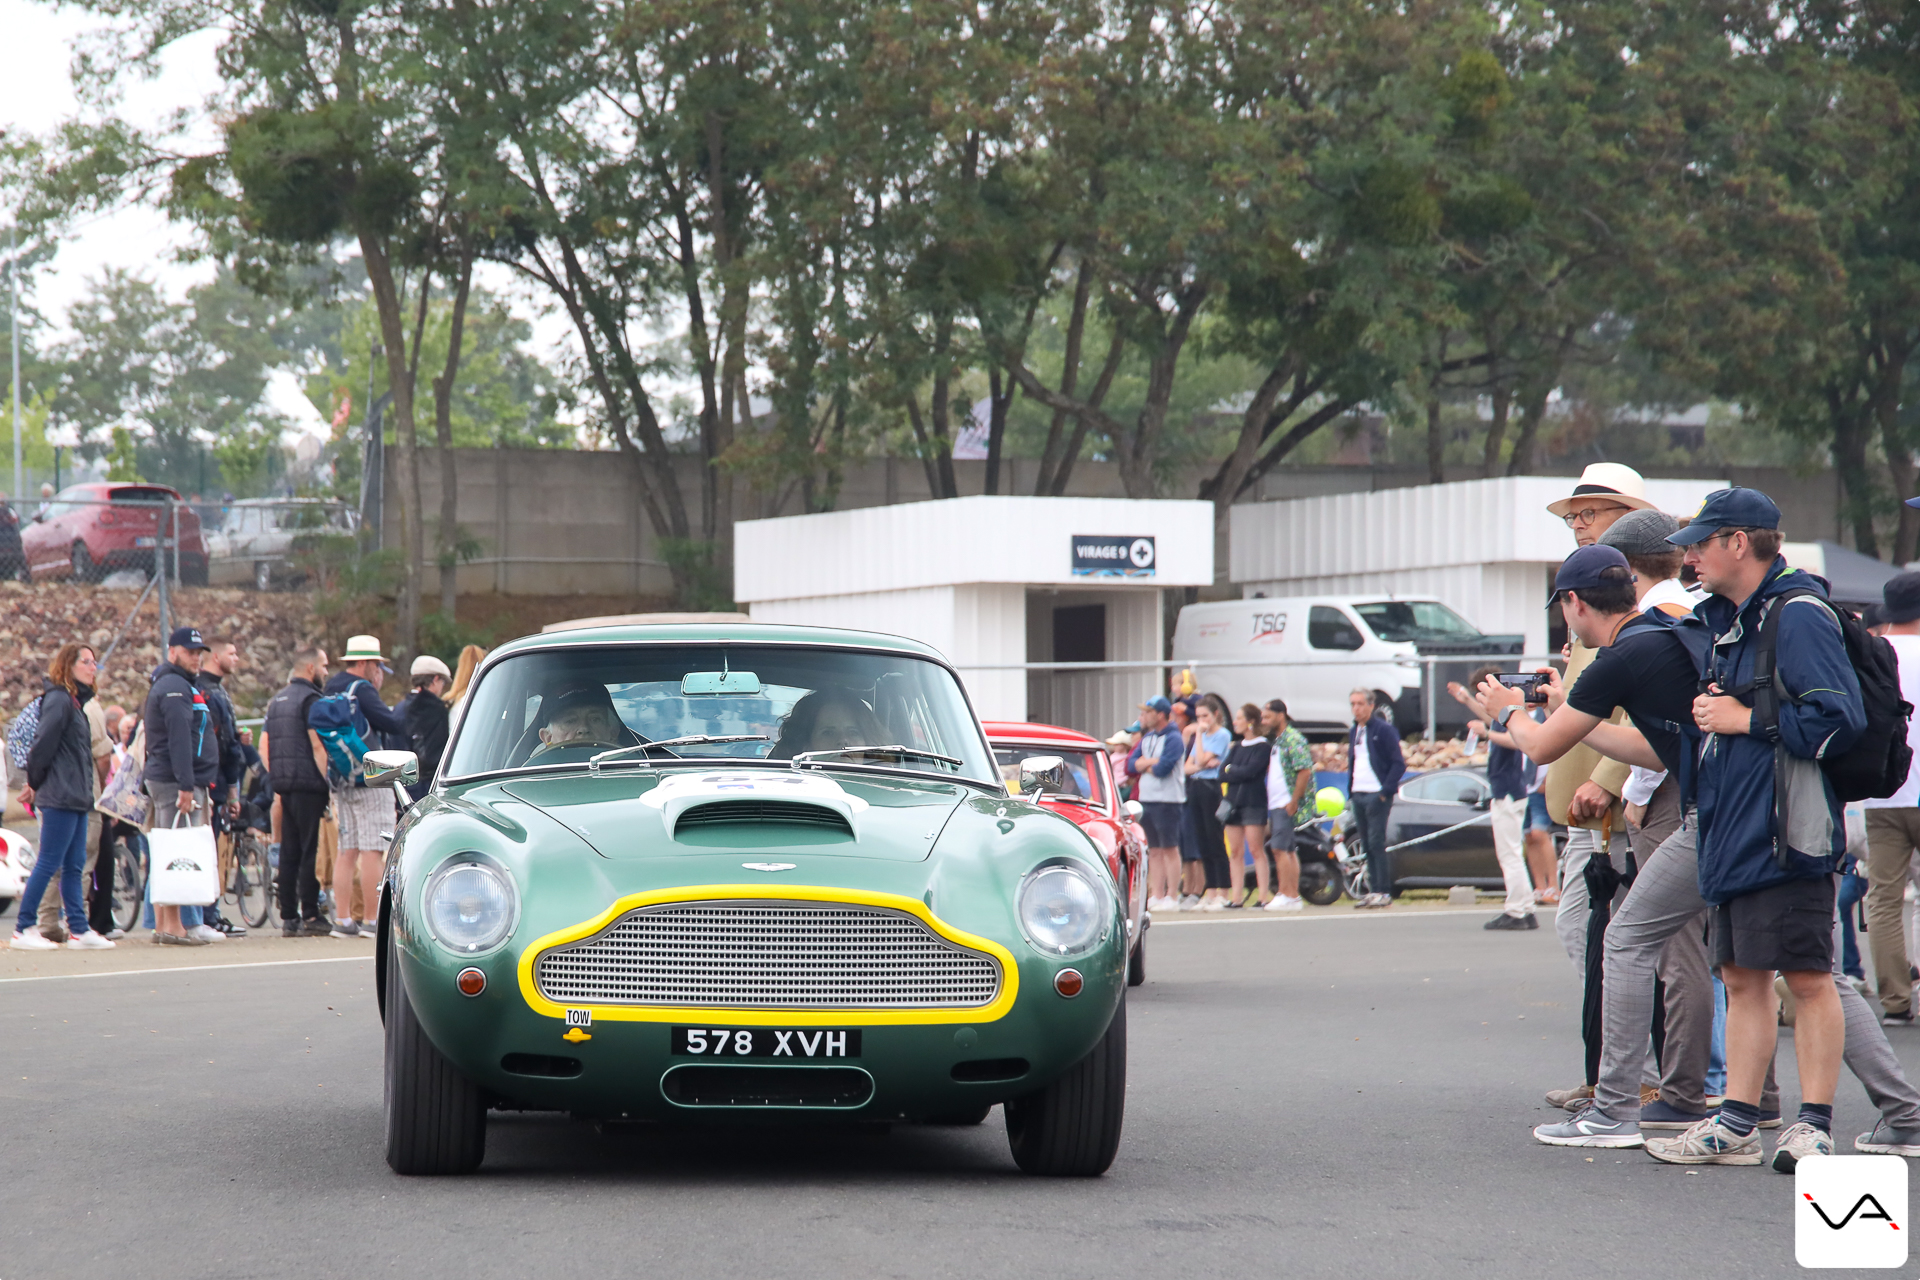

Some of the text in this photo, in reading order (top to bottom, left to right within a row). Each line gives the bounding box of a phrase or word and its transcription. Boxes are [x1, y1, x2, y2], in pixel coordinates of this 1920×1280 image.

[1076, 545, 1128, 559] VIRAGE 9
[1252, 613, 1287, 634] TSG
[567, 1010, 590, 1024] TOW
[686, 1029, 847, 1056] 578 XVH
